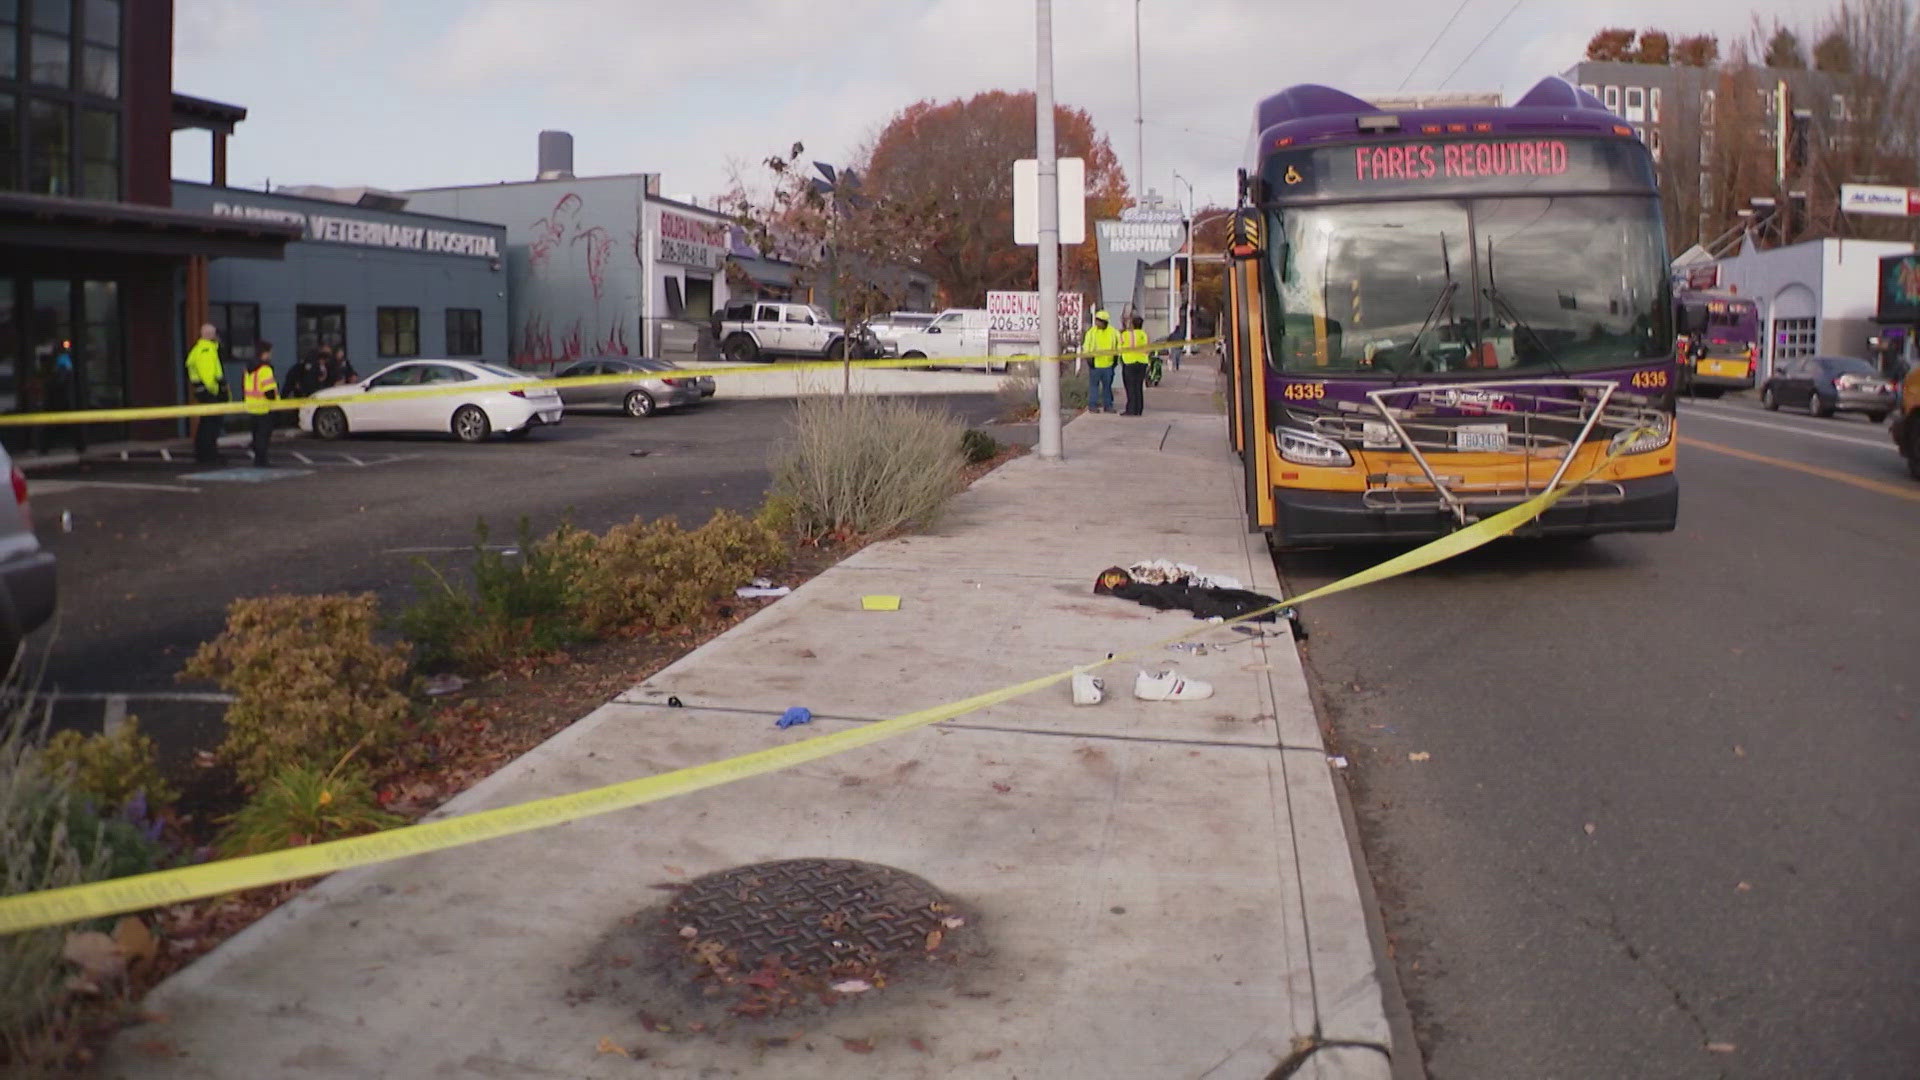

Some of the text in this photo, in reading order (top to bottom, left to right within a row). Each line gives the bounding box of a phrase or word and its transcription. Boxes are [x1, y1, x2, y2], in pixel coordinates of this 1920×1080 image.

[1356, 140, 1567, 180] FARES REQUIRED
[309, 215, 500, 258] VETERINARY HOSPITAL
[1101, 223, 1179, 239] VETERINARY
[1110, 239, 1171, 252] HOSPITAL
[989, 294, 1023, 315] GOLDEN
[1632, 371, 1667, 388] 4335
[1284, 383, 1325, 400] 4335
